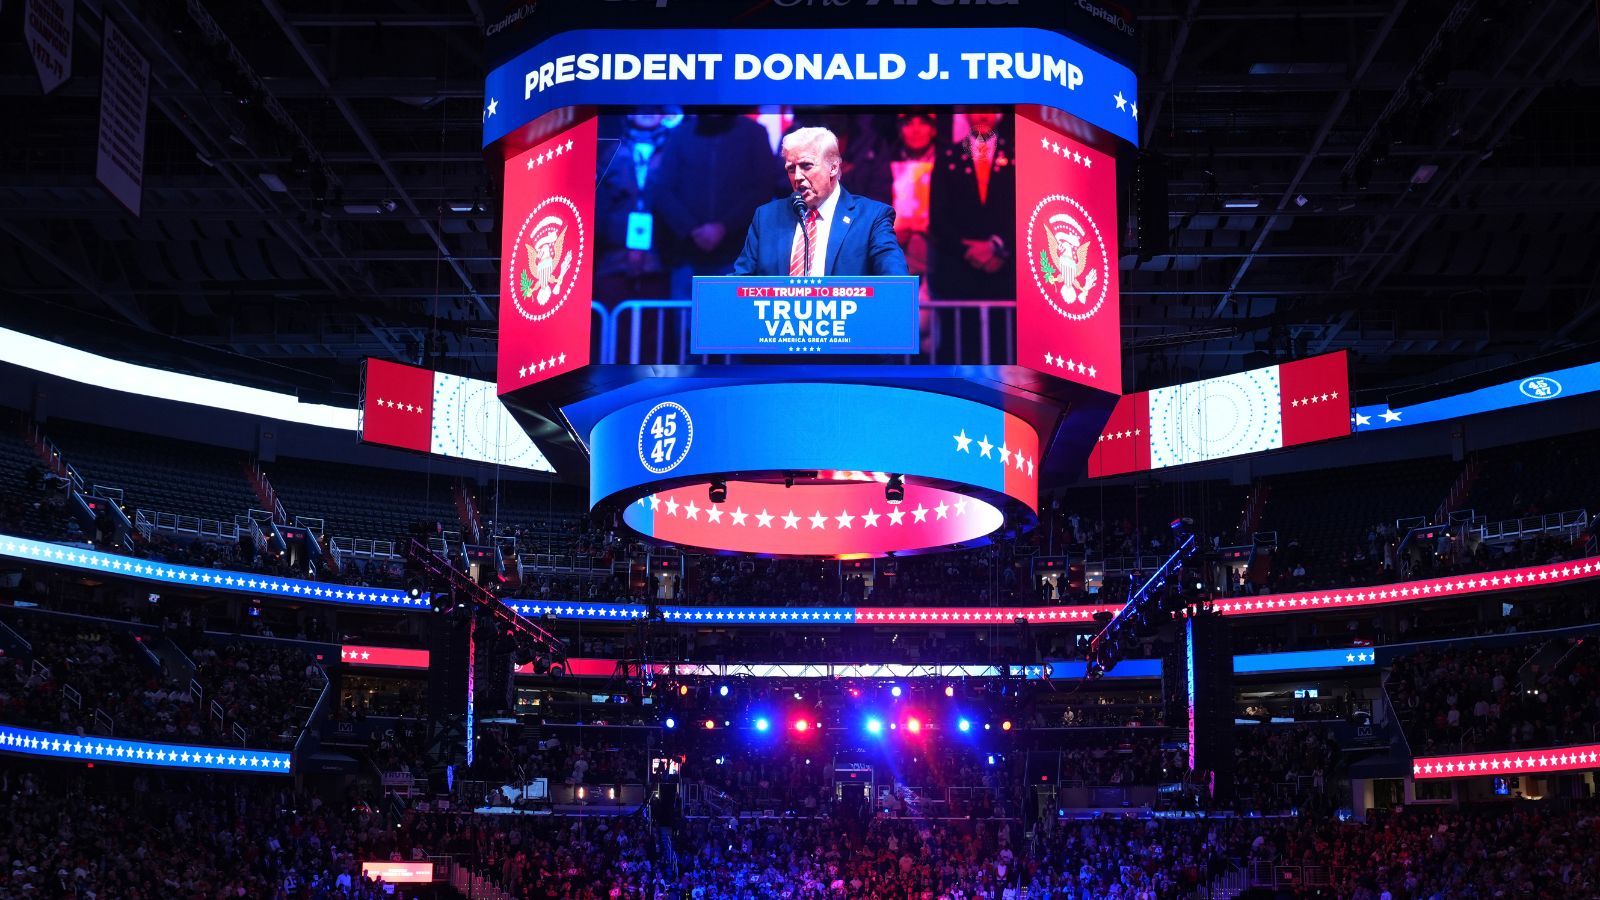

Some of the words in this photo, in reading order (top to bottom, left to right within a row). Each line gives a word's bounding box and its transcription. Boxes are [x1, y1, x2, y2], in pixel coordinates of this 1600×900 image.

[524, 53, 723, 100] PRESIDENT
[734, 53, 907, 81] DONALD
[917, 53, 950, 81] J.
[961, 52, 1085, 91] TRUMP
[742, 287, 770, 297] TEXT
[773, 286, 812, 297] TRUMP
[814, 286, 830, 297] TO
[832, 287, 867, 297] 88022
[754, 300, 858, 320] TRUMP
[765, 320, 846, 336] VANCE
[1528, 379, 1548, 390] 45
[1535, 386, 1552, 396] 47
[650, 412, 677, 439] 45
[650, 437, 677, 464] 47
